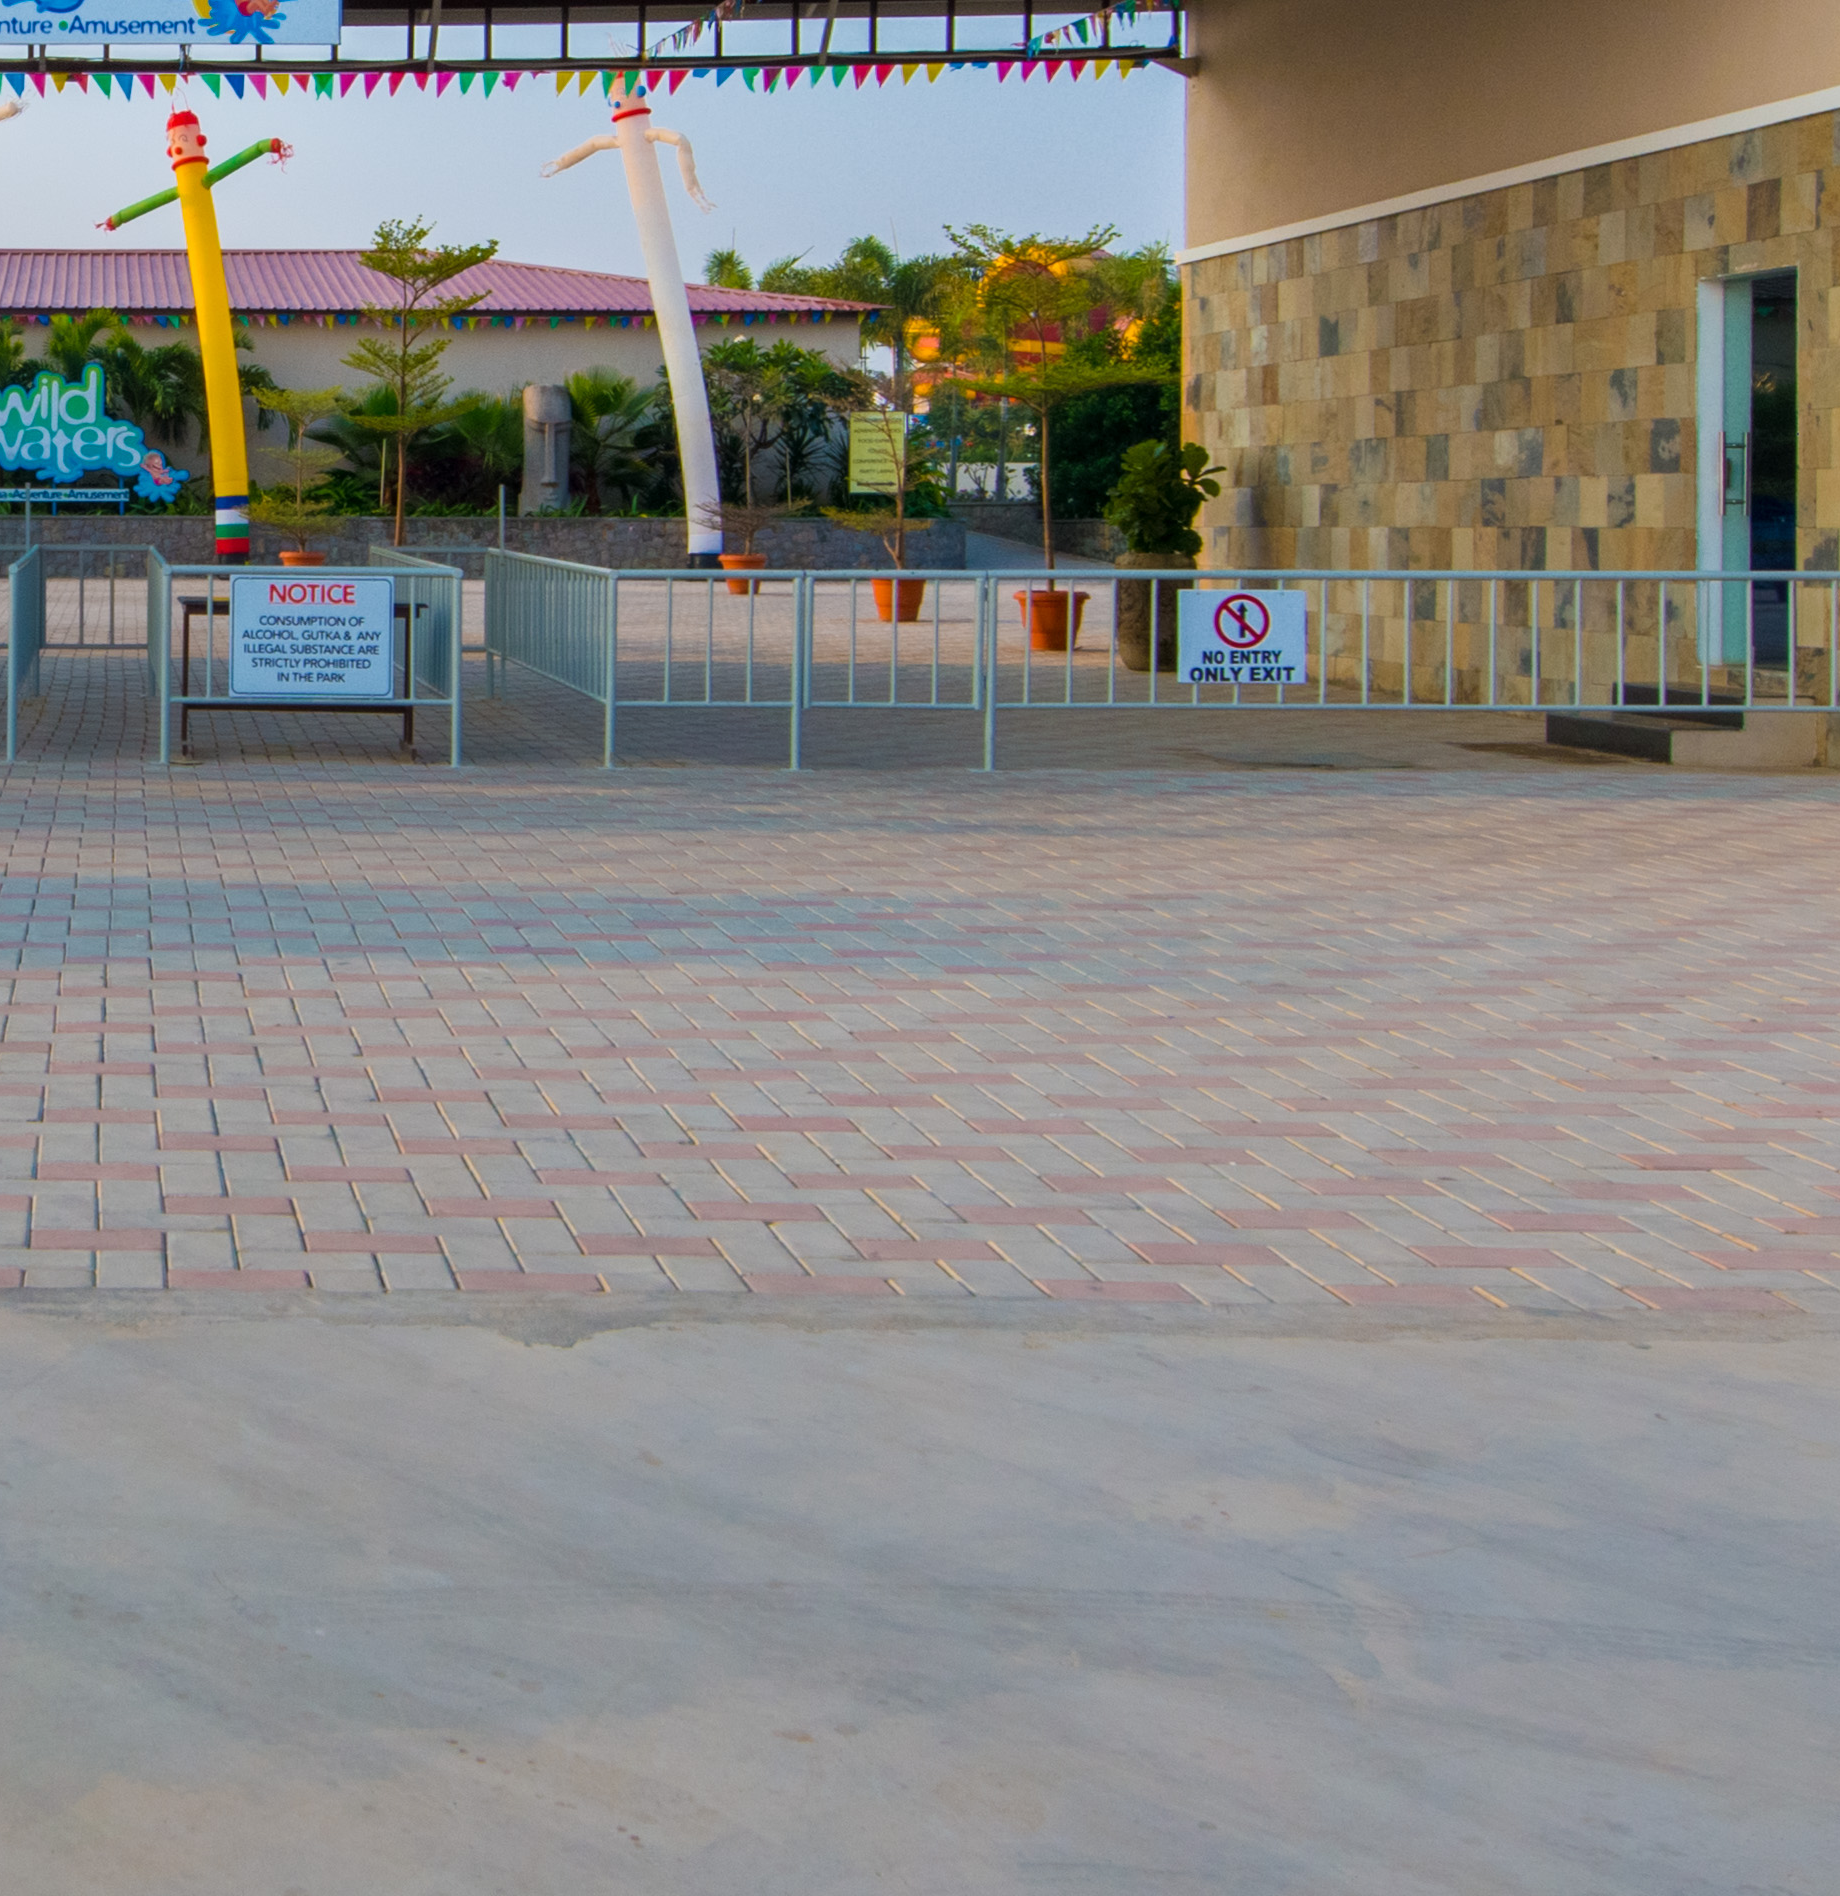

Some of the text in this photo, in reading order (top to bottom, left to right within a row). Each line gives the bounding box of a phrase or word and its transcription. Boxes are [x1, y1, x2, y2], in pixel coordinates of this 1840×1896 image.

[269, 583, 356, 604] NOTICE
[259, 615, 366, 627] CONSUMPTION OF
[301, 630, 341, 641] GUTKA
[343, 631, 352, 641] &
[357, 630, 382, 641] ANY
[243, 643, 379, 655] ILLEGAL SUBSTANCE ARE
[1202, 650, 1282, 664] NO ENTRY
[252, 658, 371, 669] STRICTLY PROHIBITED
[277, 672, 346, 683] IN THE PARK
[1189, 667, 1296, 682] ONLY EXIT
